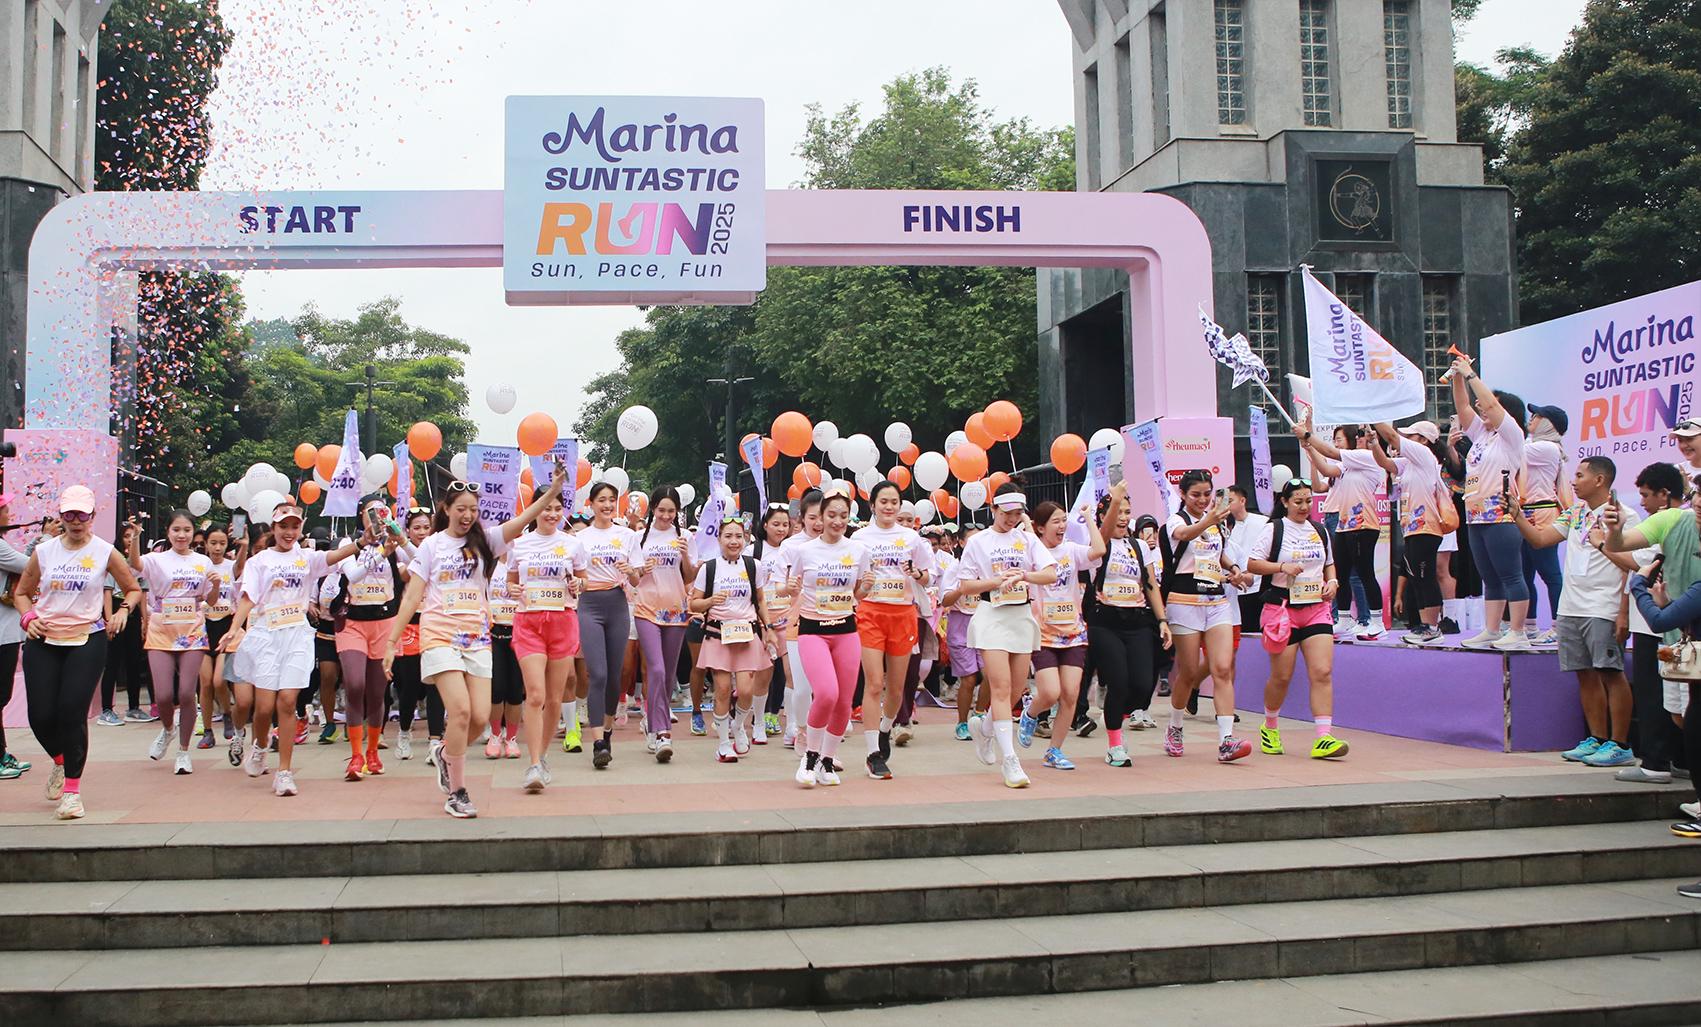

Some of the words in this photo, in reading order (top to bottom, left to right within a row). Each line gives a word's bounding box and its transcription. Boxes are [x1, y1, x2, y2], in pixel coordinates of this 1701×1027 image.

[542, 106, 739, 162] Marina
[544, 167, 740, 192] SUNTASTIC
[239, 206, 361, 233] START
[536, 202, 715, 255] RUN
[710, 203, 735, 255] 2025
[903, 205, 1021, 233] FINISH
[531, 262, 583, 279] Sun,
[598, 262, 666, 280] Pace,
[679, 262, 723, 277] Fun
[1326, 302, 1352, 384] Marina
[1350, 315, 1366, 381] SUNTAST
[1581, 314, 1695, 364] Marina
[1583, 352, 1695, 392] SUNTASTIC
[1580, 383, 1681, 442] RUN
[485, 482, 503, 494] 5K
[478, 509, 511, 524] 0:40
[480, 499, 509, 509] PACER
[458, 592, 477, 600] 3140
[540, 590, 563, 599] 3058
[174, 605, 193, 613] 3142
[280, 607, 299, 616] 3134
